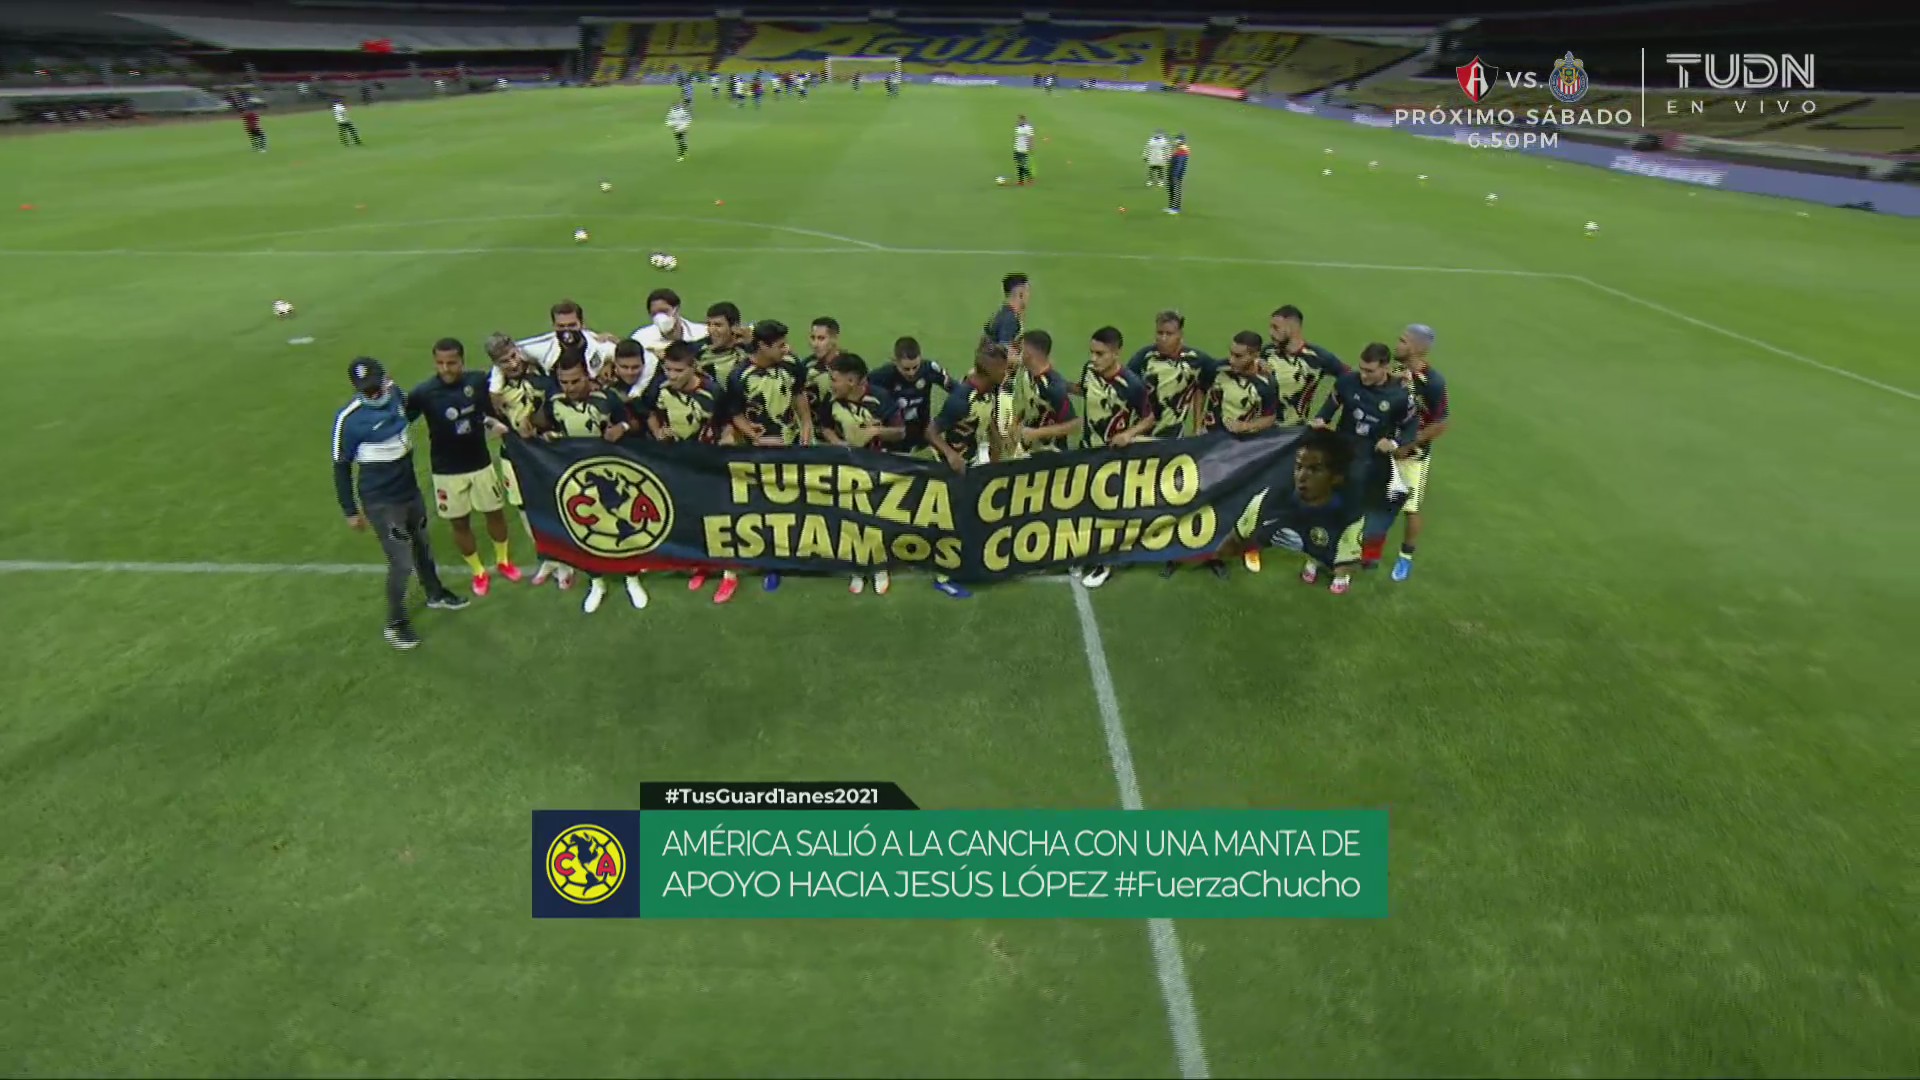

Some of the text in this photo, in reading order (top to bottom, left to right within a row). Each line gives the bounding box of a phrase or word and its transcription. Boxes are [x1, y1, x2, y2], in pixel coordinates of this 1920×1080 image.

[728, 453, 1199, 531] FUERZA CHUCHO
[703, 505, 1217, 572] ESTAMOS CONTIGO
